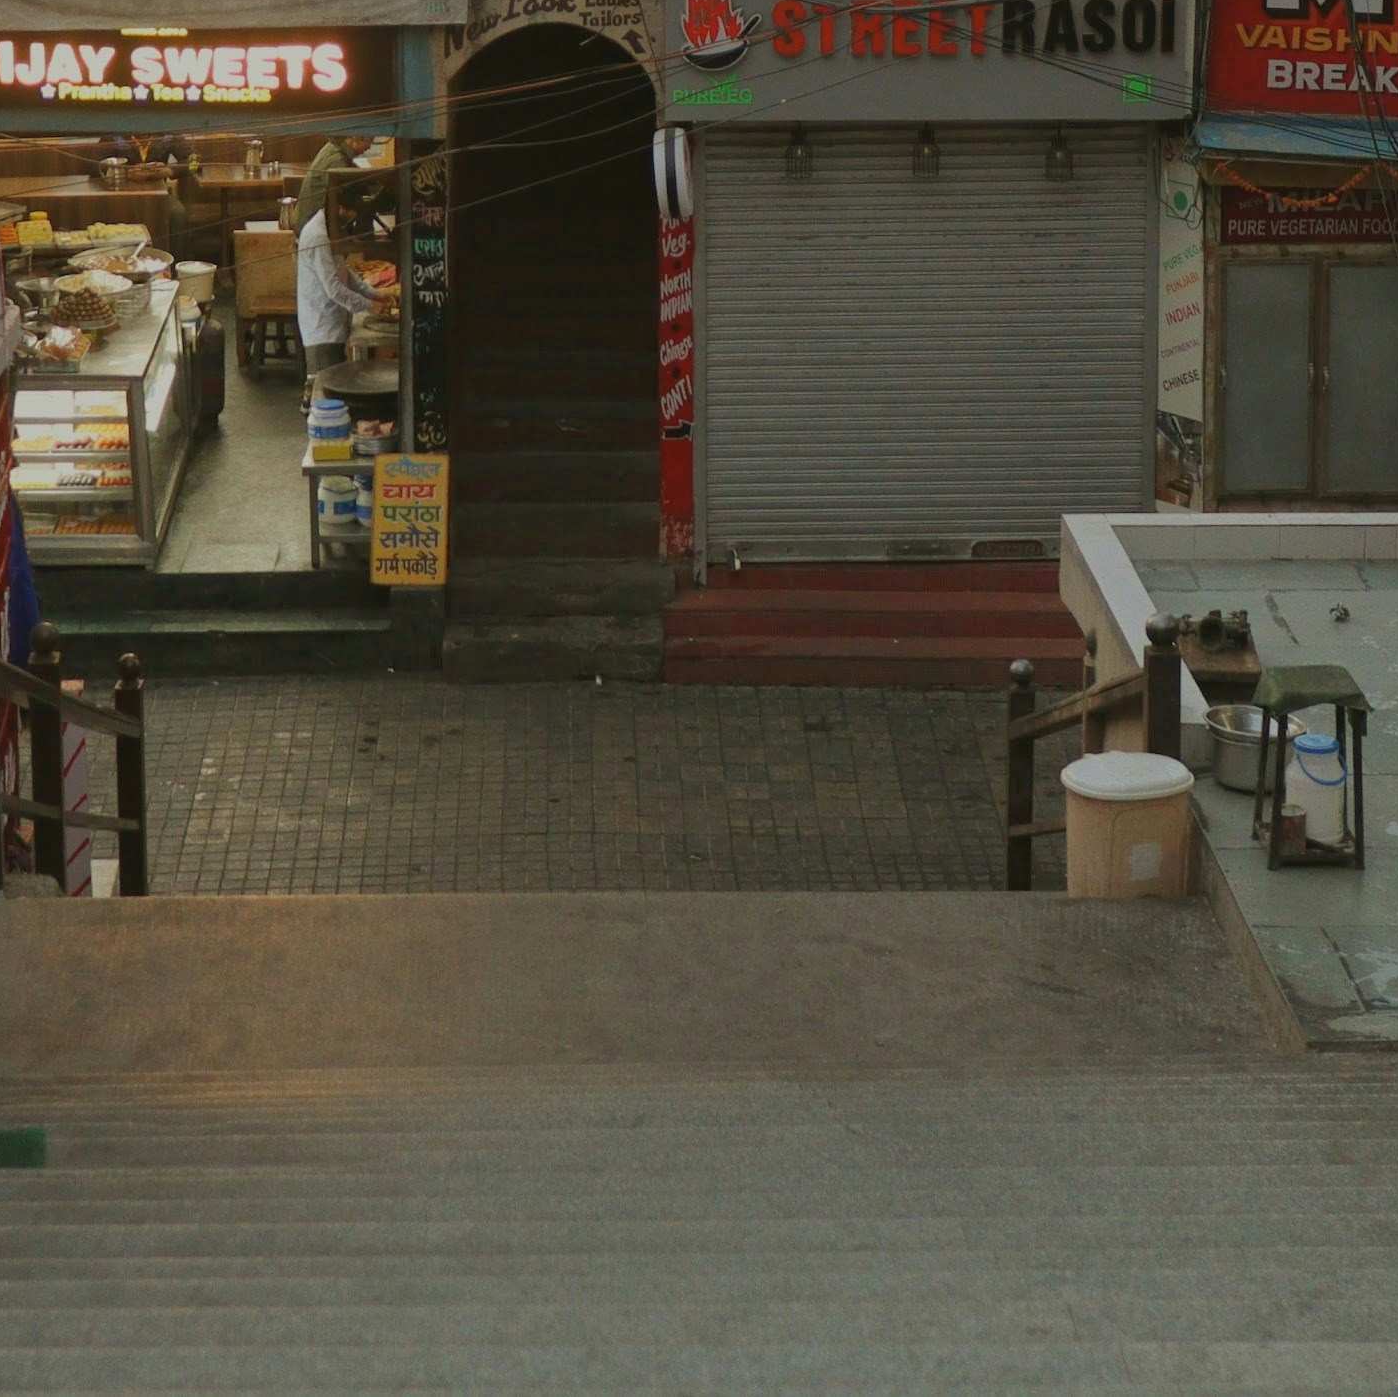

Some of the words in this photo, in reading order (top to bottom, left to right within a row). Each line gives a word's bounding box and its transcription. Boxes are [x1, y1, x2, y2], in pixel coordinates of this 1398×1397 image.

[579, 9, 643, 28] Tailors
[444, 12, 499, 59] New
[130, 42, 348, 92] SWEETS
[150, 82, 185, 102] Tea
[202, 83, 272, 104] Snacks
[1228, 220, 1266, 236] PURE
[1270, 217, 1358, 236] VEGETARIAN
[660, 267, 692, 300] NORTH
[1164, 271, 1200, 295] PUNJABI
[660, 290, 693, 323] INDIAN
[1165, 302, 1202, 327] INDIAN
[659, 334, 693, 367] Chinese
[1162, 368, 1201, 392] CHINESE
[382, 483, 436, 499] चाय
